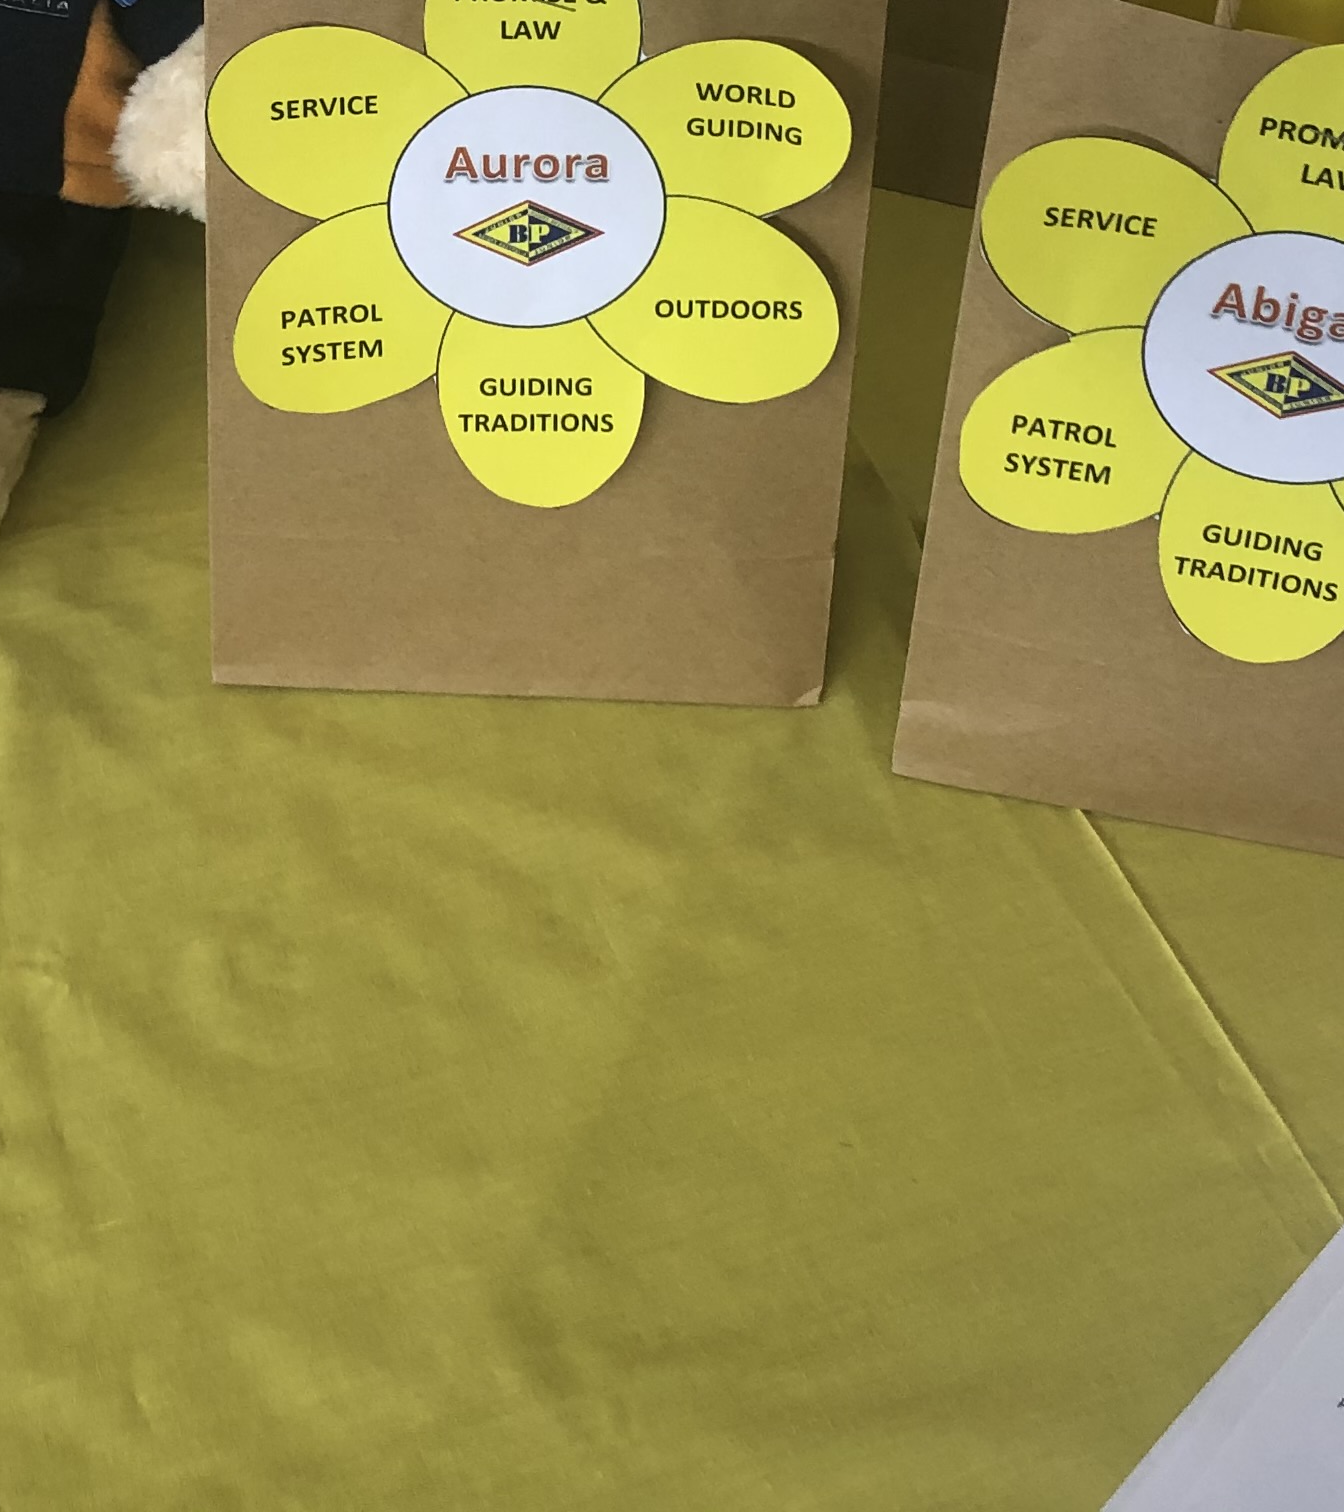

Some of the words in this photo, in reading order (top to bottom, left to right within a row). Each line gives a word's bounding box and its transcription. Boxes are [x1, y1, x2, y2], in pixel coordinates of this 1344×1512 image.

[501, 20, 562, 40] LAW
[270, 95, 378, 121] SERVICE
[695, 82, 796, 109] WORLD
[686, 117, 802, 146] GUIDING
[444, 146, 610, 183] Aurora
[508, 224, 550, 244] BP
[1043, 206, 1158, 238] SERVICE
[281, 303, 383, 330] PATROL
[654, 299, 803, 320] OUTDOORS
[281, 339, 383, 366] SYSTEM
[479, 377, 593, 397] GUIDING
[1265, 372, 1312, 398] BP
[458, 413, 614, 433] TRADITIONS
[1011, 414, 1117, 449] PATROL
[1003, 453, 1112, 486] SYSTEM
[1202, 524, 1324, 562] GUIDING
[1174, 555, 1339, 602] TRADITIONS
